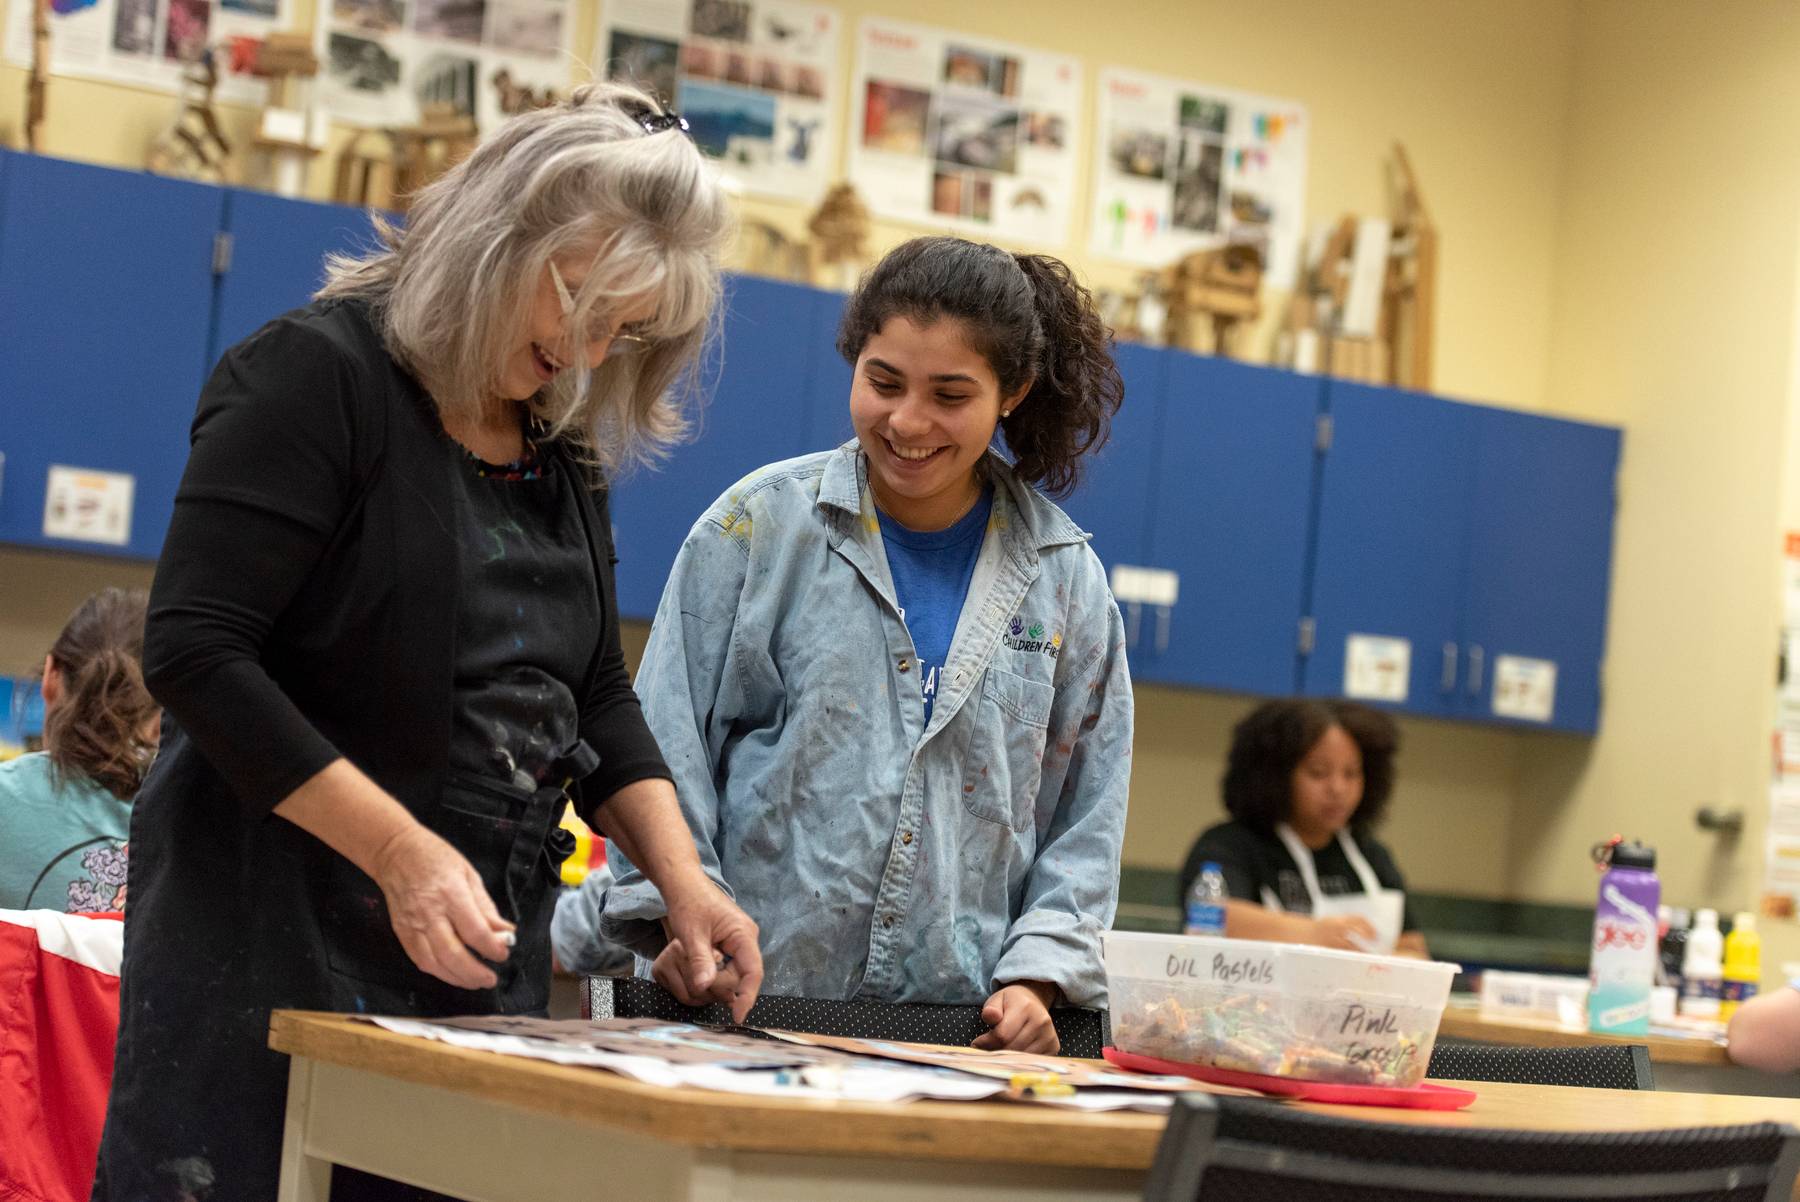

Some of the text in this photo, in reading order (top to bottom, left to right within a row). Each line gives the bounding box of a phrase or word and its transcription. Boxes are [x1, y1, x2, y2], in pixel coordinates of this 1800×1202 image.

[1002, 634, 1043, 653] CHILDREN
[1166, 952, 1274, 984] OIL Pastels
[1339, 1004, 1398, 1034] Pink
